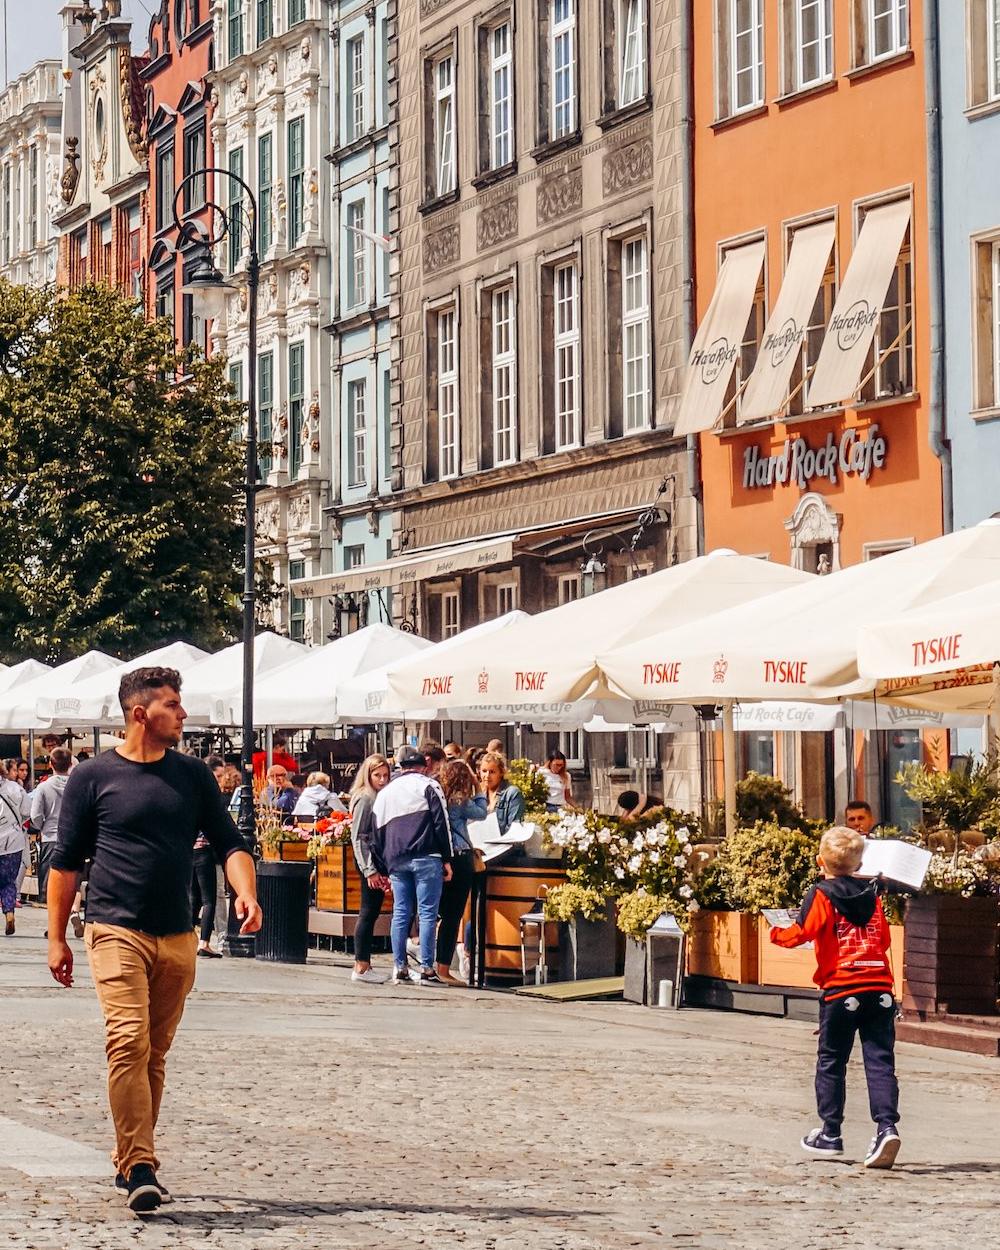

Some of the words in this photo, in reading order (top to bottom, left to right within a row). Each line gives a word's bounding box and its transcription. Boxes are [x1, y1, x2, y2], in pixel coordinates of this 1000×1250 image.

[742, 439, 790, 488] Hard
[790, 432, 838, 489] Rock
[839, 424, 886, 479] Cafe
[912, 634, 962, 667] TYSKIE
[515, 672, 549, 691] TYSKIE
[643, 662, 682, 684] TYSKIE
[764, 661, 808, 684] TYSKIE
[422, 676, 453, 696] TYSKIE
[754, 707, 784, 723] Rock
[786, 707, 815, 723] Cafe
